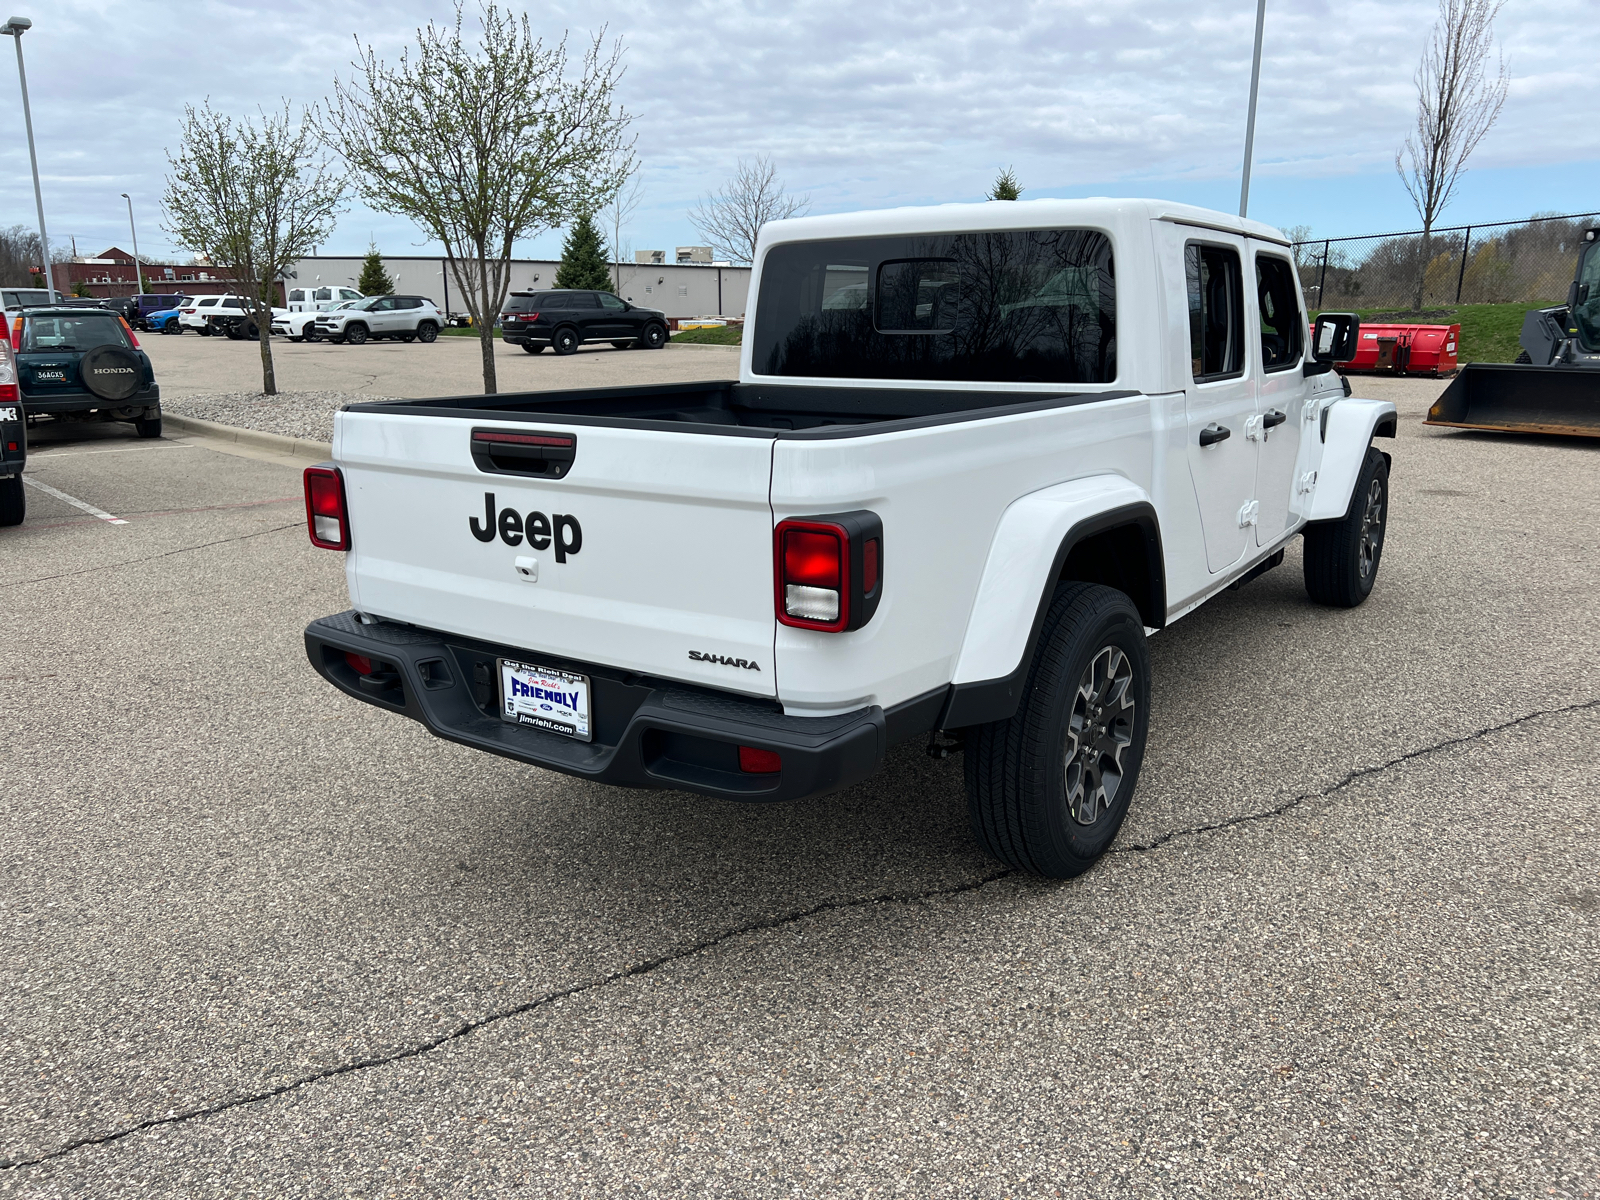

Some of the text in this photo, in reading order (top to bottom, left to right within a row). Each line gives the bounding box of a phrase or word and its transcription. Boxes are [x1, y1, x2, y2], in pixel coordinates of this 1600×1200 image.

[93, 367, 135, 375] HONDA
[468, 491, 583, 564] Jeep
[503, 660, 520, 668] Get
[538, 667, 560, 677] Riehl
[562, 672, 582, 681] Deal
[688, 650, 761, 671] SAHARA
[511, 675, 579, 712] FRIENDLY
[528, 677, 540, 685] Jim
[541, 679, 561, 690] Riehl's
[519, 714, 573, 734] jimriehl.com
